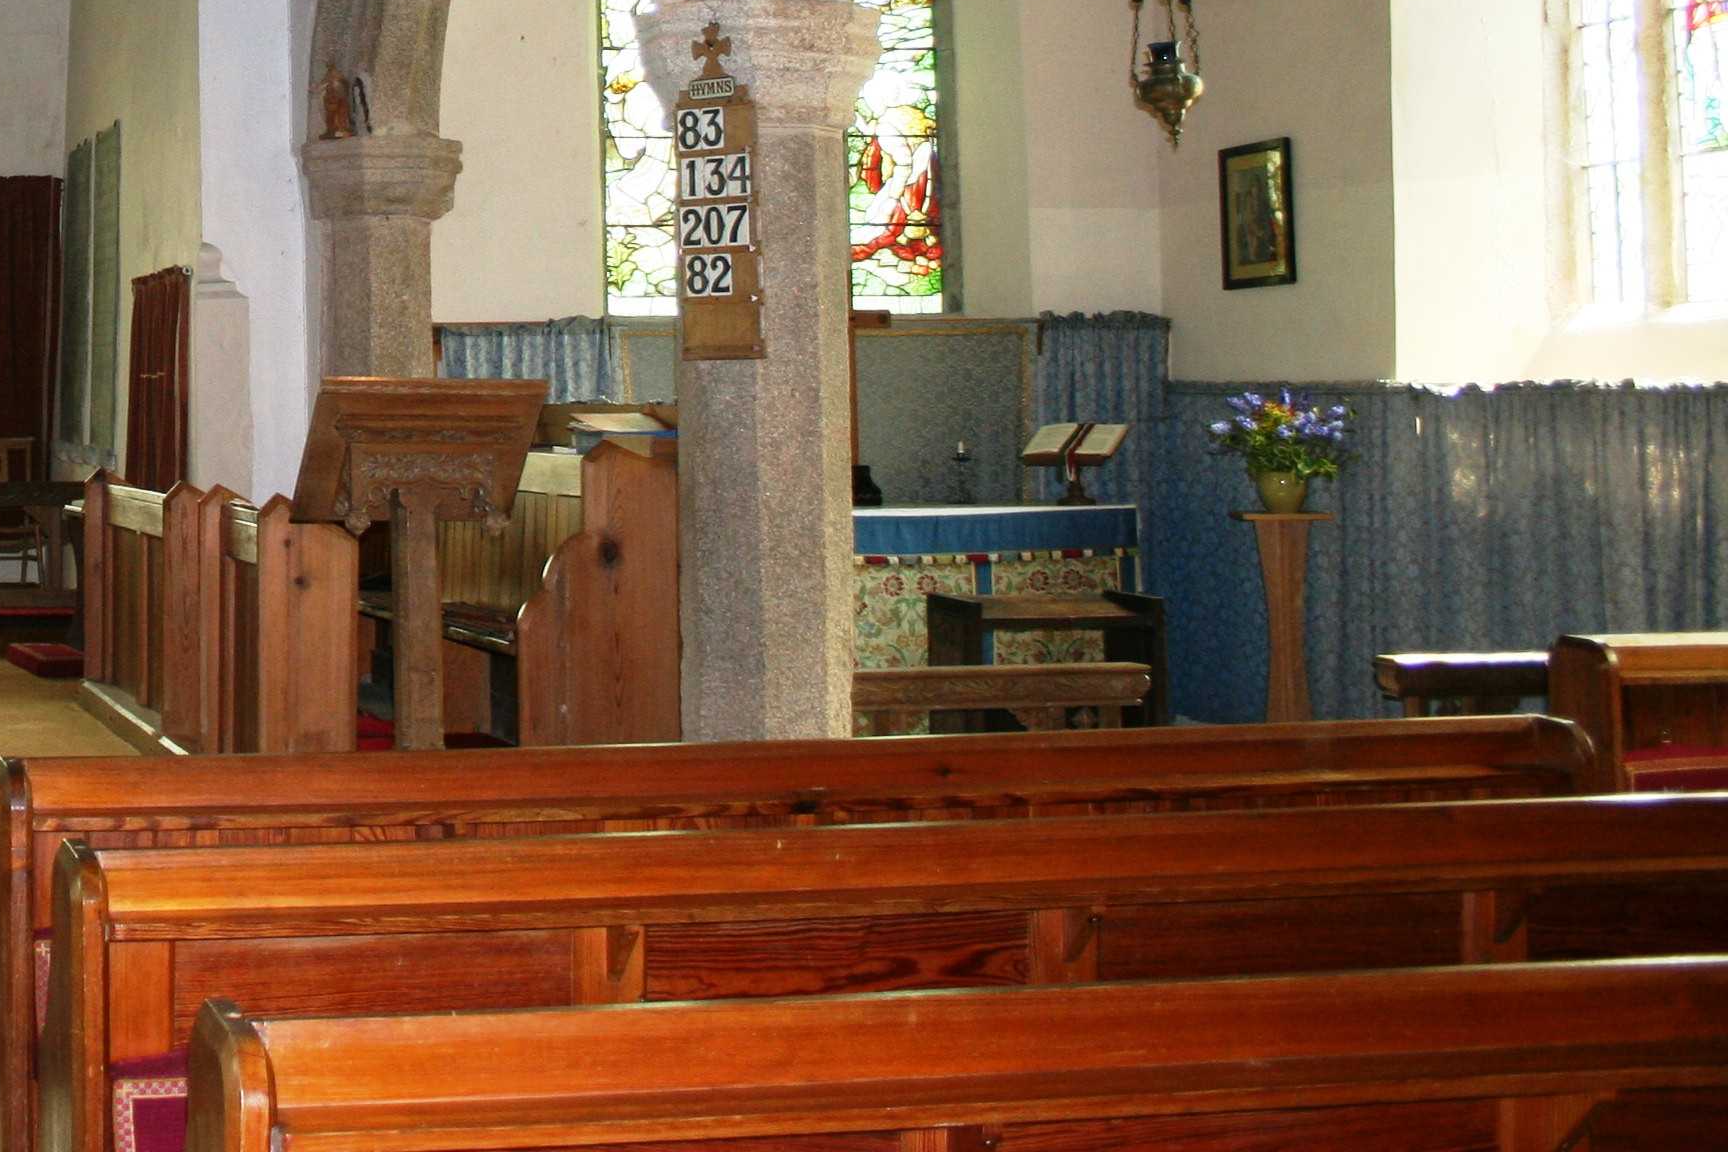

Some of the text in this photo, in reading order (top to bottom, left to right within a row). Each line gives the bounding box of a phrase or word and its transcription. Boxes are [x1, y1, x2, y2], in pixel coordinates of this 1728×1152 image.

[690, 79, 733, 97] HYMNS
[679, 109, 723, 149] 83
[686, 156, 751, 197] 134
[682, 205, 747, 246] 207
[687, 255, 731, 294] 82
